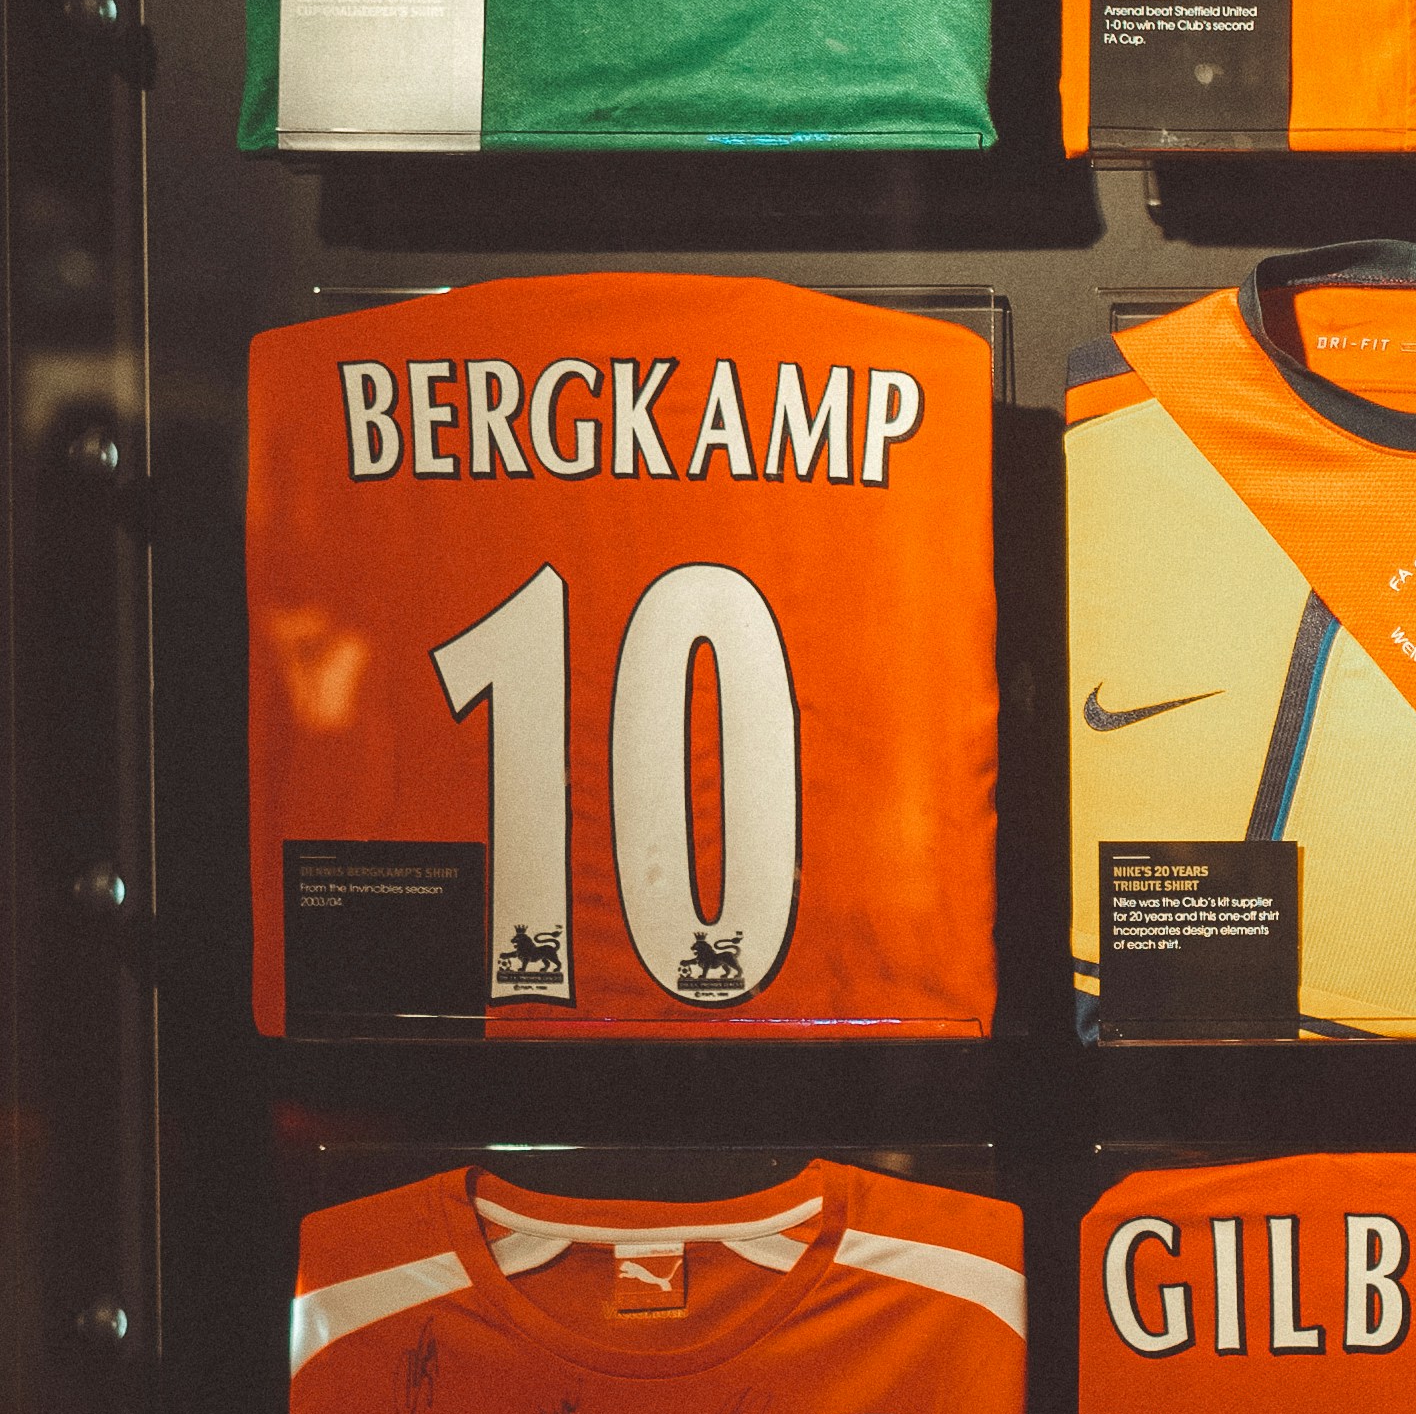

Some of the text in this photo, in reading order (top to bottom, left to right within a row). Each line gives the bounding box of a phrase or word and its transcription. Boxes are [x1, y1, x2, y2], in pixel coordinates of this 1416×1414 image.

[1104, 6, 1257, 17] Arsenal beat Sheffield United
[1106, 20, 1254, 31] 1-0 to win the Club's second
[1104, 34, 1145, 46] FA Cup.
[1317, 337, 1390, 351] DRI-FIT
[339, 358, 924, 488] BERGKAMP
[1389, 568, 1413, 592] FA
[430, 560, 803, 1008] 10
[425, 868, 459, 878] SHIRT
[1113, 866, 1209, 877] NIKE'S 20 YEARS
[300, 883, 443, 894] From the season
[1114, 880, 1199, 891] TRIBUTE SHIRT
[1113, 897, 1273, 908] Nike was the Club's kit supplier
[1113, 911, 1279, 923] for 20 years and this one-off shirt
[1183, 925, 1269, 937] design elements
[1114, 940, 1181, 949] of each shirt.
